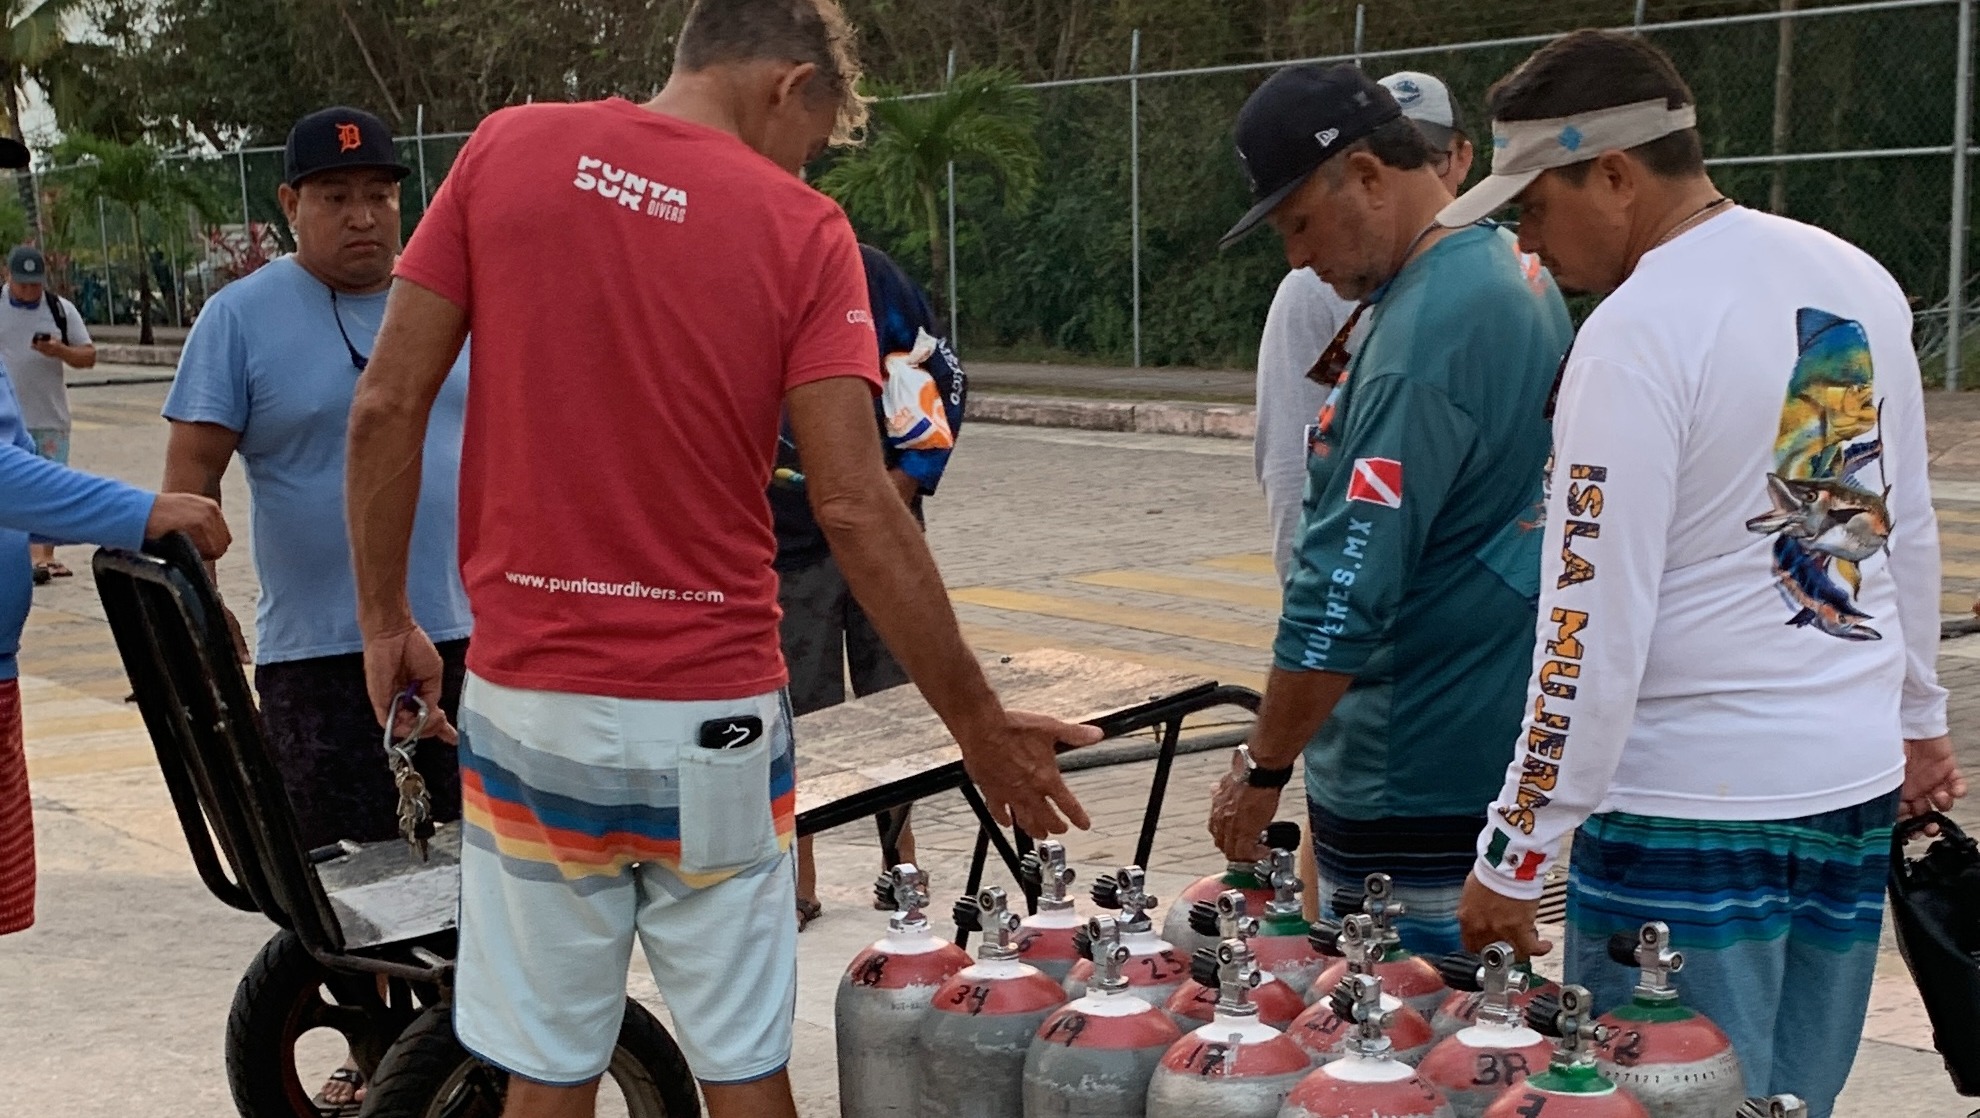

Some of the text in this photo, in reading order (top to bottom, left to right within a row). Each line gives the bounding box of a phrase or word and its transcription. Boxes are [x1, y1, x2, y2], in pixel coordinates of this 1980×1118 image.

[335, 123, 361, 154] D
[573, 172, 643, 212] SUR
[577, 155, 688, 207] PUNTA
[646, 199, 686, 224] DIVERS
[1556, 463, 1608, 590] ISLA
[504, 571, 725, 603] www.puntasurdivers.com
[949, 984, 990, 1017] 34
[1043, 1014, 1087, 1048] 19
